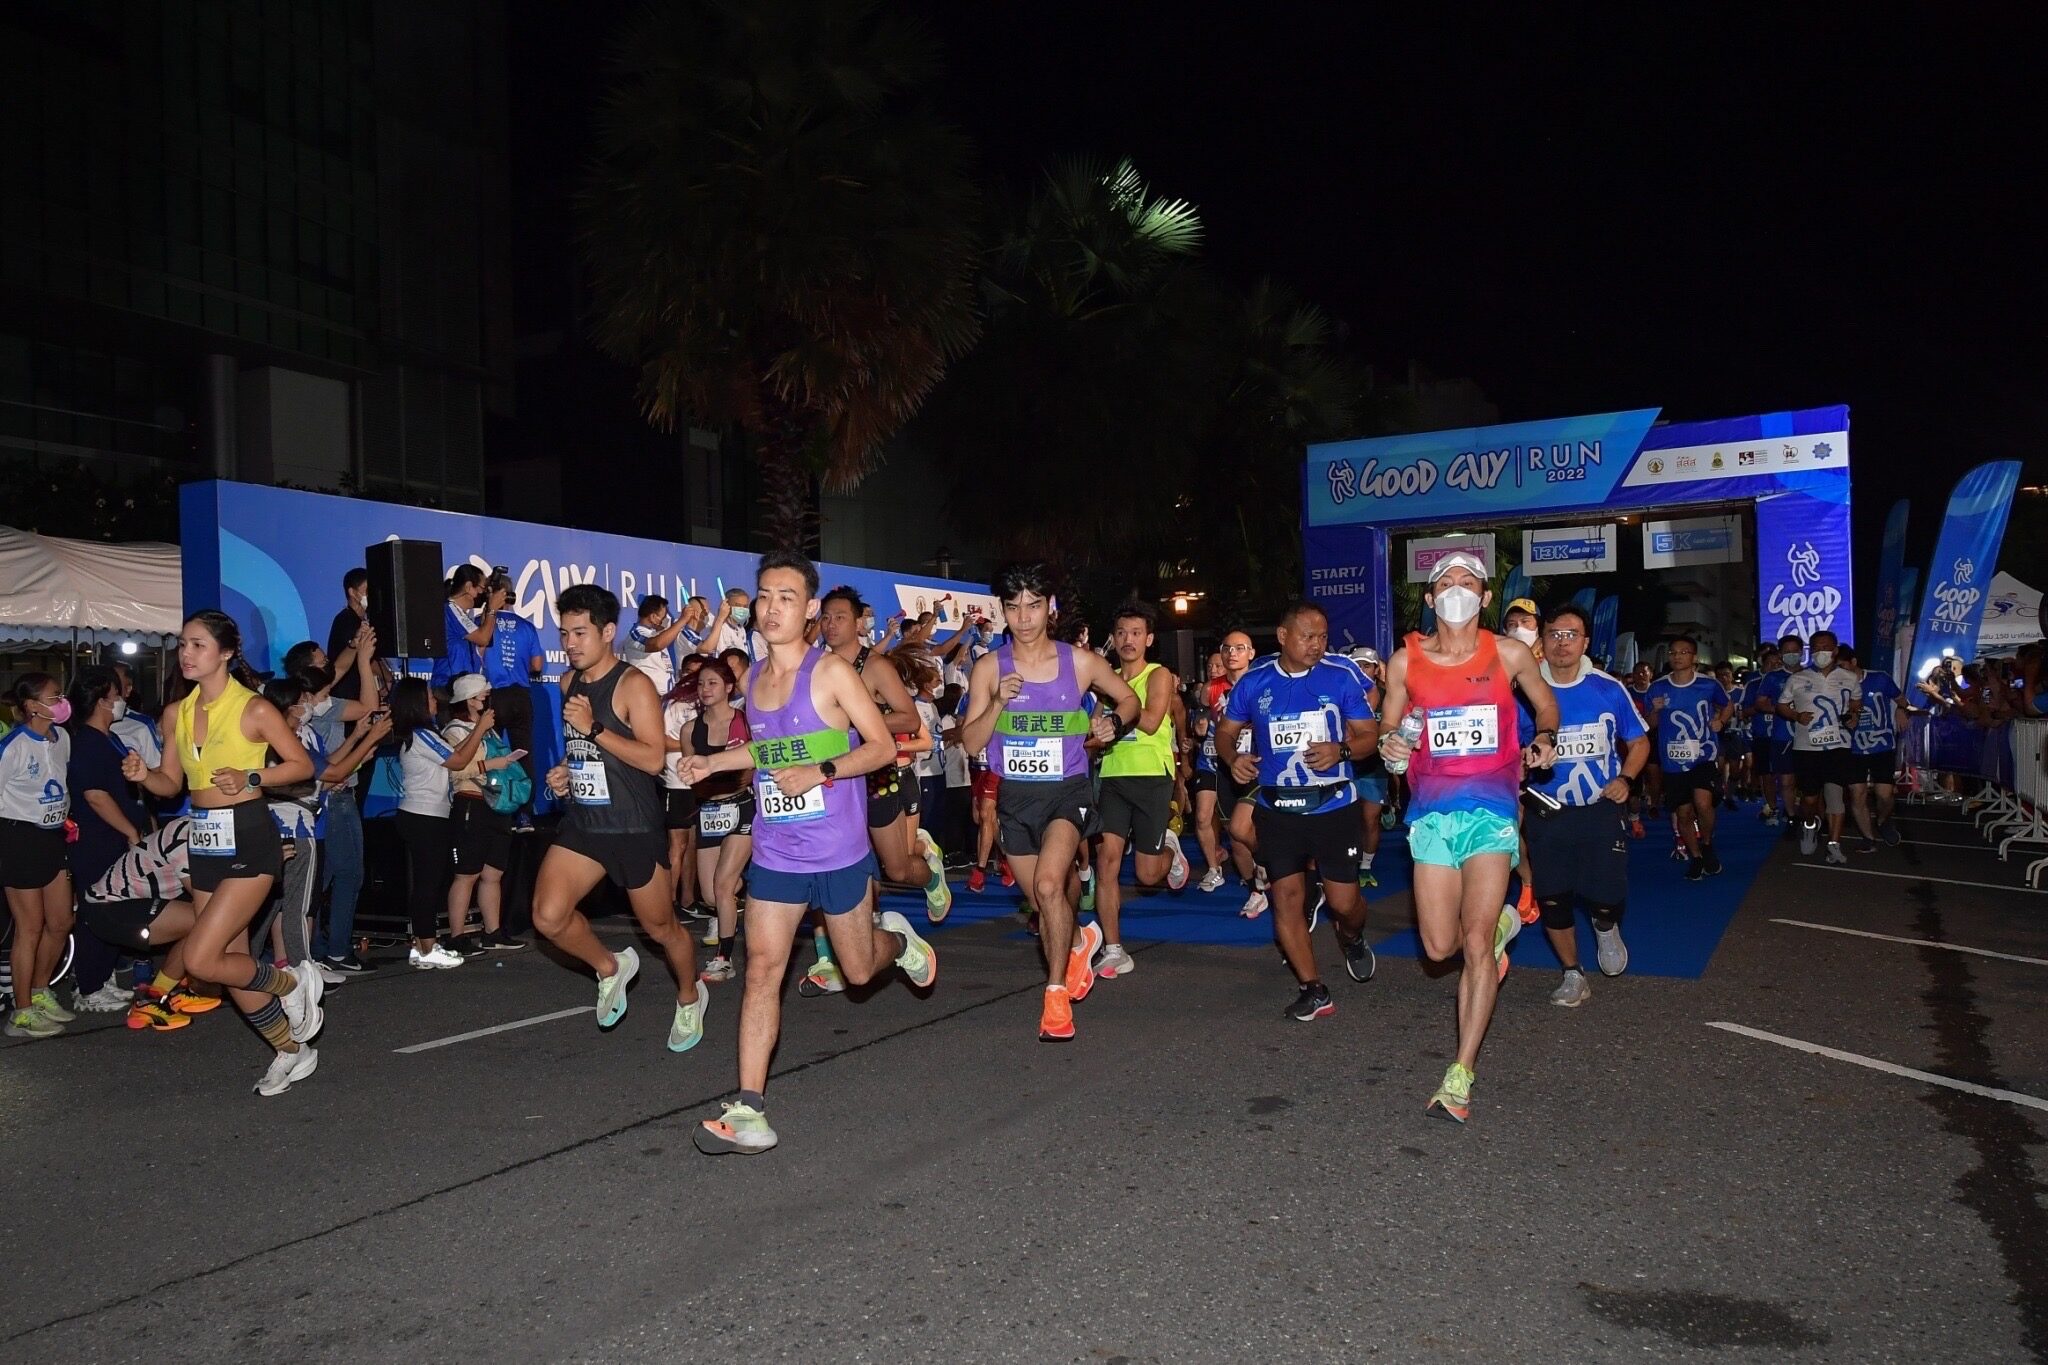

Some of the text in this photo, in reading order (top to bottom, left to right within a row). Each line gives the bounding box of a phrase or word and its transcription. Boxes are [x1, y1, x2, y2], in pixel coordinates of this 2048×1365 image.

[1359, 441, 1601, 498] GOOD GUY RUN
[1547, 469, 1585, 482] 2022
[1656, 532, 1691, 552] 5K
[1533, 544, 1569, 561] 13K
[1312, 566, 1366, 580] START/
[621, 570, 697, 613] RUN
[1313, 583, 1365, 597] FINISH
[1934, 581, 1980, 604] GOOD
[1767, 584, 1842, 617] GOOD
[1935, 602, 1973, 622] GUY
[1931, 622, 1967, 635] RUN
[1012, 714, 1066, 733] 暖武里
[1433, 729, 1482, 748] 0479
[1578, 733, 1596, 741] 13K
[1032, 750, 1051, 758] 13K
[1556, 742, 1595, 757] 0102
[1669, 750, 1692, 758] 0269
[1008, 758, 1049, 773] 0656
[581, 773, 596, 781] 13K
[572, 782, 596, 797] 492
[764, 794, 806, 814] 0380
[205, 822, 222, 830] 13K
[703, 819, 731, 831] 0490
[192, 832, 219, 847] 0491
